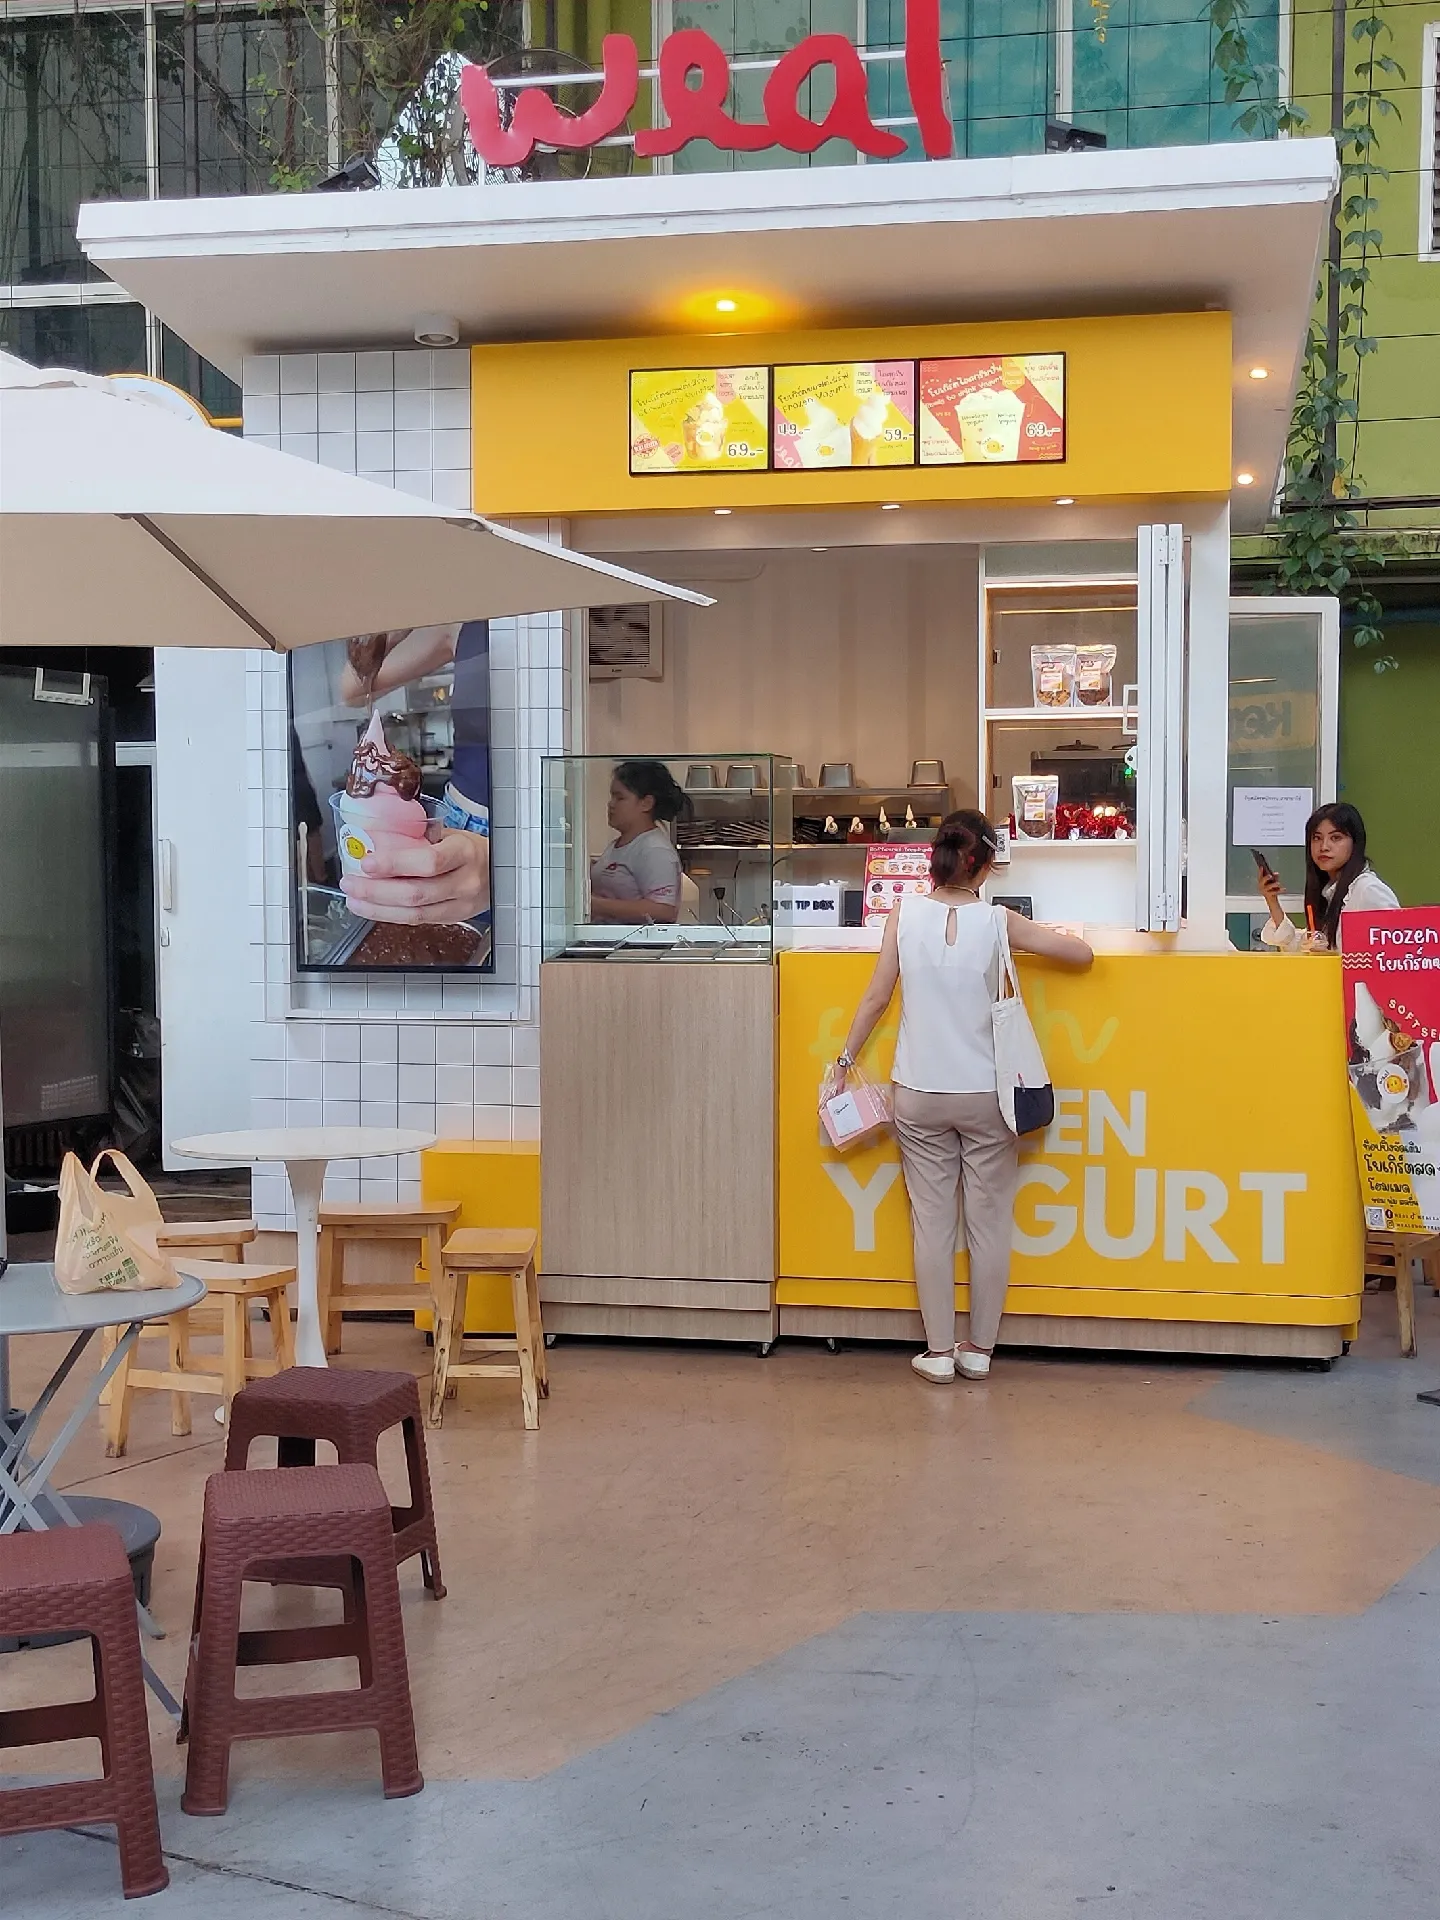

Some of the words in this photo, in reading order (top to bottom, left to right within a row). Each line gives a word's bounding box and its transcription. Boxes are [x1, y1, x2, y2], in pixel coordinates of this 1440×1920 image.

[461, 0, 956, 166] weal
[795, 899, 811, 911] TIP
[812, 899, 835, 911] BOX
[1369, 926, 1439, 947] Frozen
[1364, 1153, 1436, 1177] โยเกิร์ตสด
[1367, 1177, 1411, 1193] โฮมเมด
[821, 1162, 1308, 1265] YGURT
